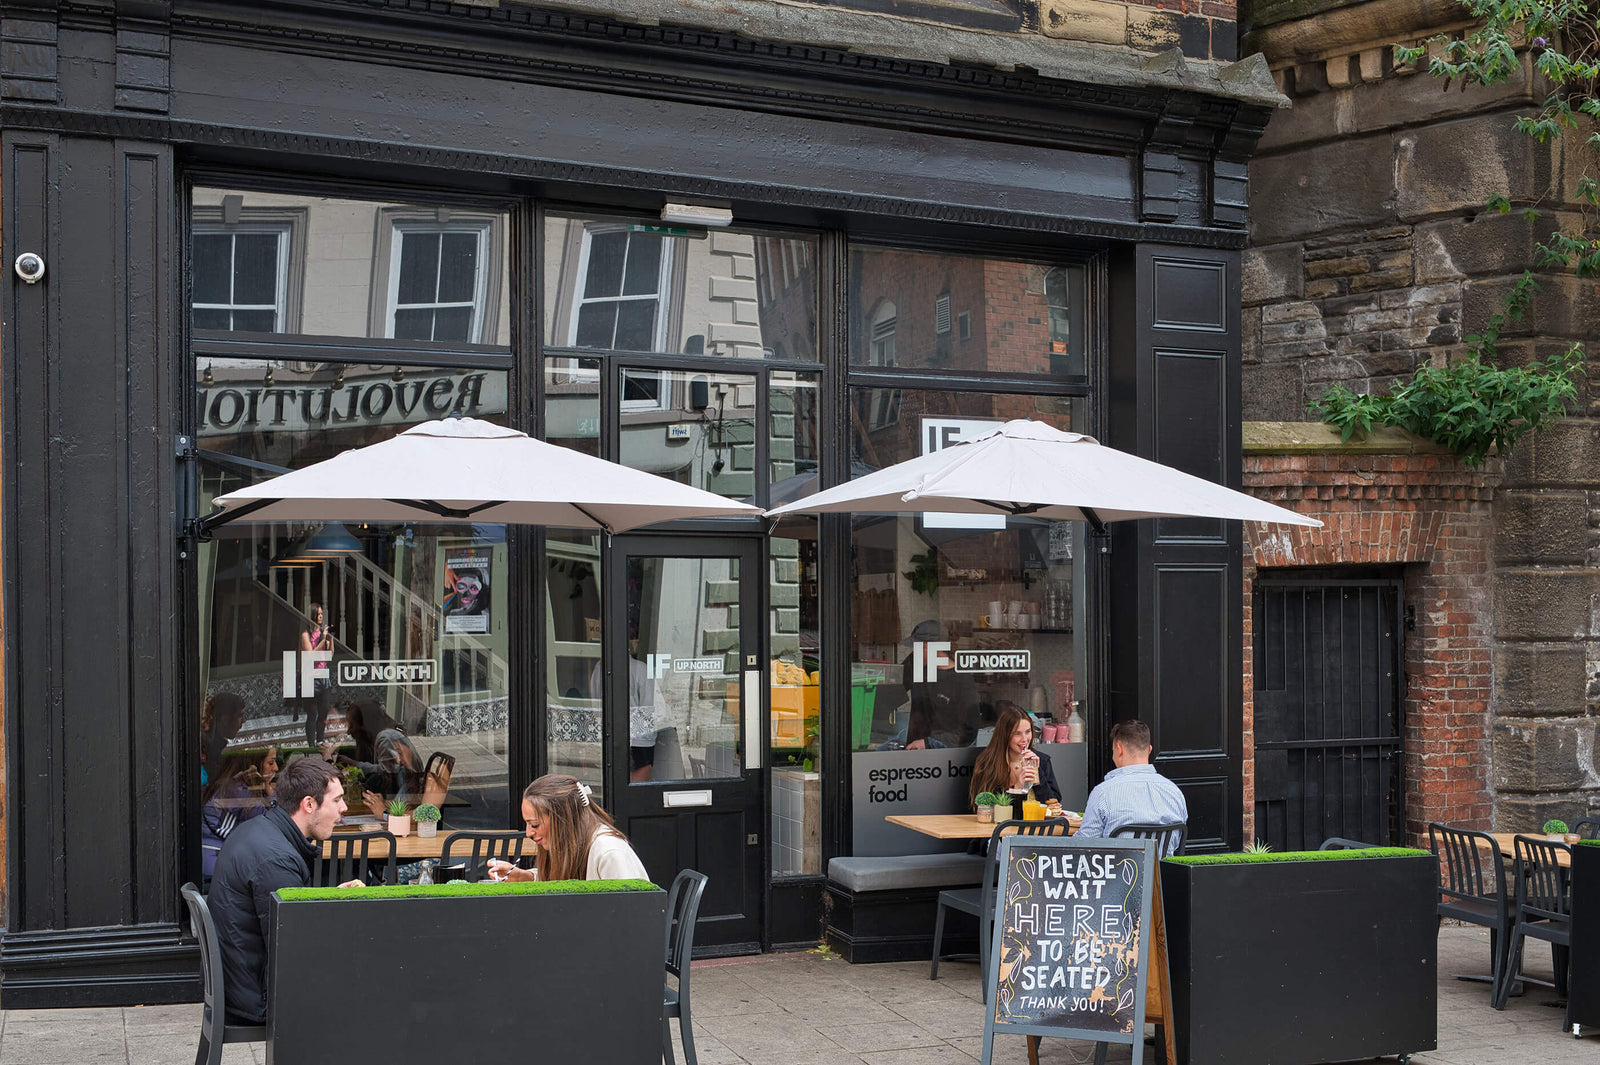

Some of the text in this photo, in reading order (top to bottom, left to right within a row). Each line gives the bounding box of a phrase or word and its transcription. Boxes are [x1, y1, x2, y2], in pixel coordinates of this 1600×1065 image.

[282, 650, 431, 698] IF UP NORTH
[646, 653, 721, 679] IF UP NORTH
[913, 641, 1025, 682] IF UP NORTH
[868, 766, 942, 785] espresso
[868, 783, 908, 803] food
[1038, 854, 1117, 879] PLEASE
[1043, 880, 1106, 900] WAIT
[1014, 903, 1123, 938] HERE
[1036, 939, 1103, 964] TO BE
[1021, 965, 1111, 990] SEATED
[1020, 996, 1104, 1013] THANK YOU!
